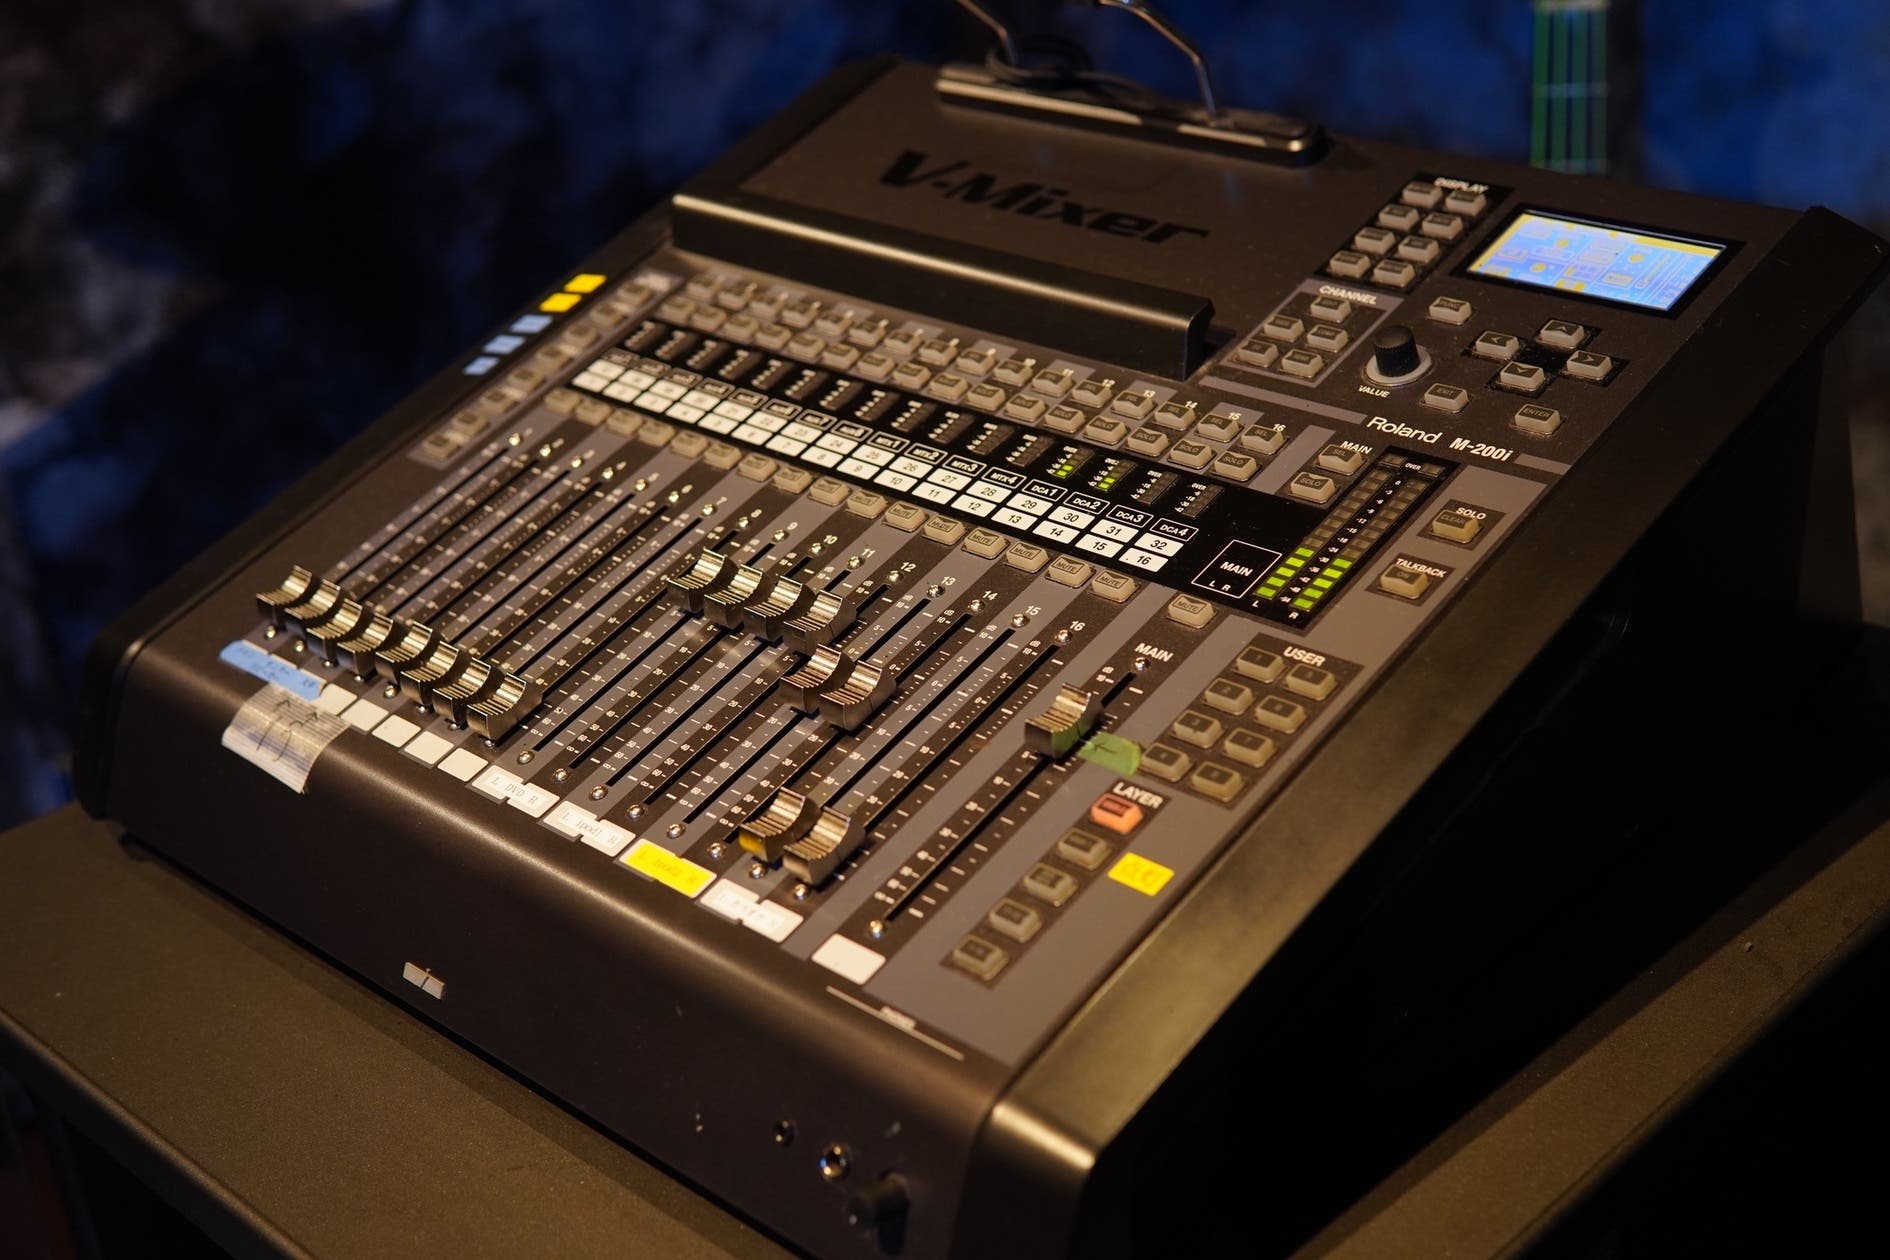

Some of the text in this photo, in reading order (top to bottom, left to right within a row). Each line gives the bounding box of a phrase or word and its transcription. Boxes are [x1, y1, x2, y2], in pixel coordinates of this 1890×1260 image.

[880, 150, 1210, 243] V-Mixer
[1320, 285, 1376, 304] CHANNEL
[1358, 385, 1390, 398] VALUE
[1436, 387, 1455, 396] EXIT
[1184, 401, 1198, 409] 14
[1228, 412, 1242, 420] 15
[1523, 407, 1551, 418] ENTER
[1272, 423, 1286, 432] 16
[1136, 432, 1156, 441] SOLO
[1366, 416, 1514, 462] Roland M-200i
[1179, 443, 1199, 454] SOLO
[1340, 440, 1373, 454] MAIN
[951, 460, 978, 472] MTX3
[1223, 455, 1243, 466] SOLO
[1404, 461, 1422, 471] OVER
[903, 462, 917, 471] 26
[890, 476, 903, 485] 10
[941, 474, 957, 483] 27
[990, 472, 1018, 484] MTX4
[1300, 477, 1322, 487] SOLO
[928, 489, 940, 497] 11
[980, 487, 996, 496] 28
[967, 501, 981, 510] 12
[1020, 499, 1037, 509] 29
[1072, 496, 1101, 510] DCA2
[1007, 514, 1022, 524] 13
[1062, 512, 1080, 522] 30
[1115, 509, 1145, 523] DCA3
[1456, 507, 1486, 520] SOLO
[1049, 527, 1064, 536] 14
[1106, 525, 1121, 536] 31
[1159, 523, 1189, 536] DCA4
[823, 534, 838, 545] 10
[971, 532, 992, 544] MUTE
[1092, 541, 1107, 550] 15
[1150, 539, 1167, 550] 32
[861, 547, 876, 558] 11
[1014, 547, 1033, 557] MUTE
[1136, 554, 1152, 565] 16
[900, 561, 917, 572] 12
[1057, 561, 1077, 572] MUTE
[1220, 561, 1253, 577] MAIN
[1395, 558, 1447, 578] TALKBACK
[941, 575, 956, 586] 13
[1101, 575, 1122, 587] MUTE
[981, 589, 998, 600] 14
[1025, 604, 1042, 616] 15
[1177, 600, 1198, 612] MUTE
[936, 616, 946, 624] 10
[1288, 612, 1299, 620] R
[1069, 620, 1085, 631] 16
[1022, 647, 1033, 655] 10
[1134, 642, 1174, 662] MAIN
[1282, 646, 1326, 667] USER
[974, 696, 982, 704] 0
[948, 721, 956, 729] 5
[876, 728, 887, 736] 10
[919, 745, 930, 754] 10
[504, 784, 526, 798] DVD
[1112, 781, 1164, 809] LAYER
